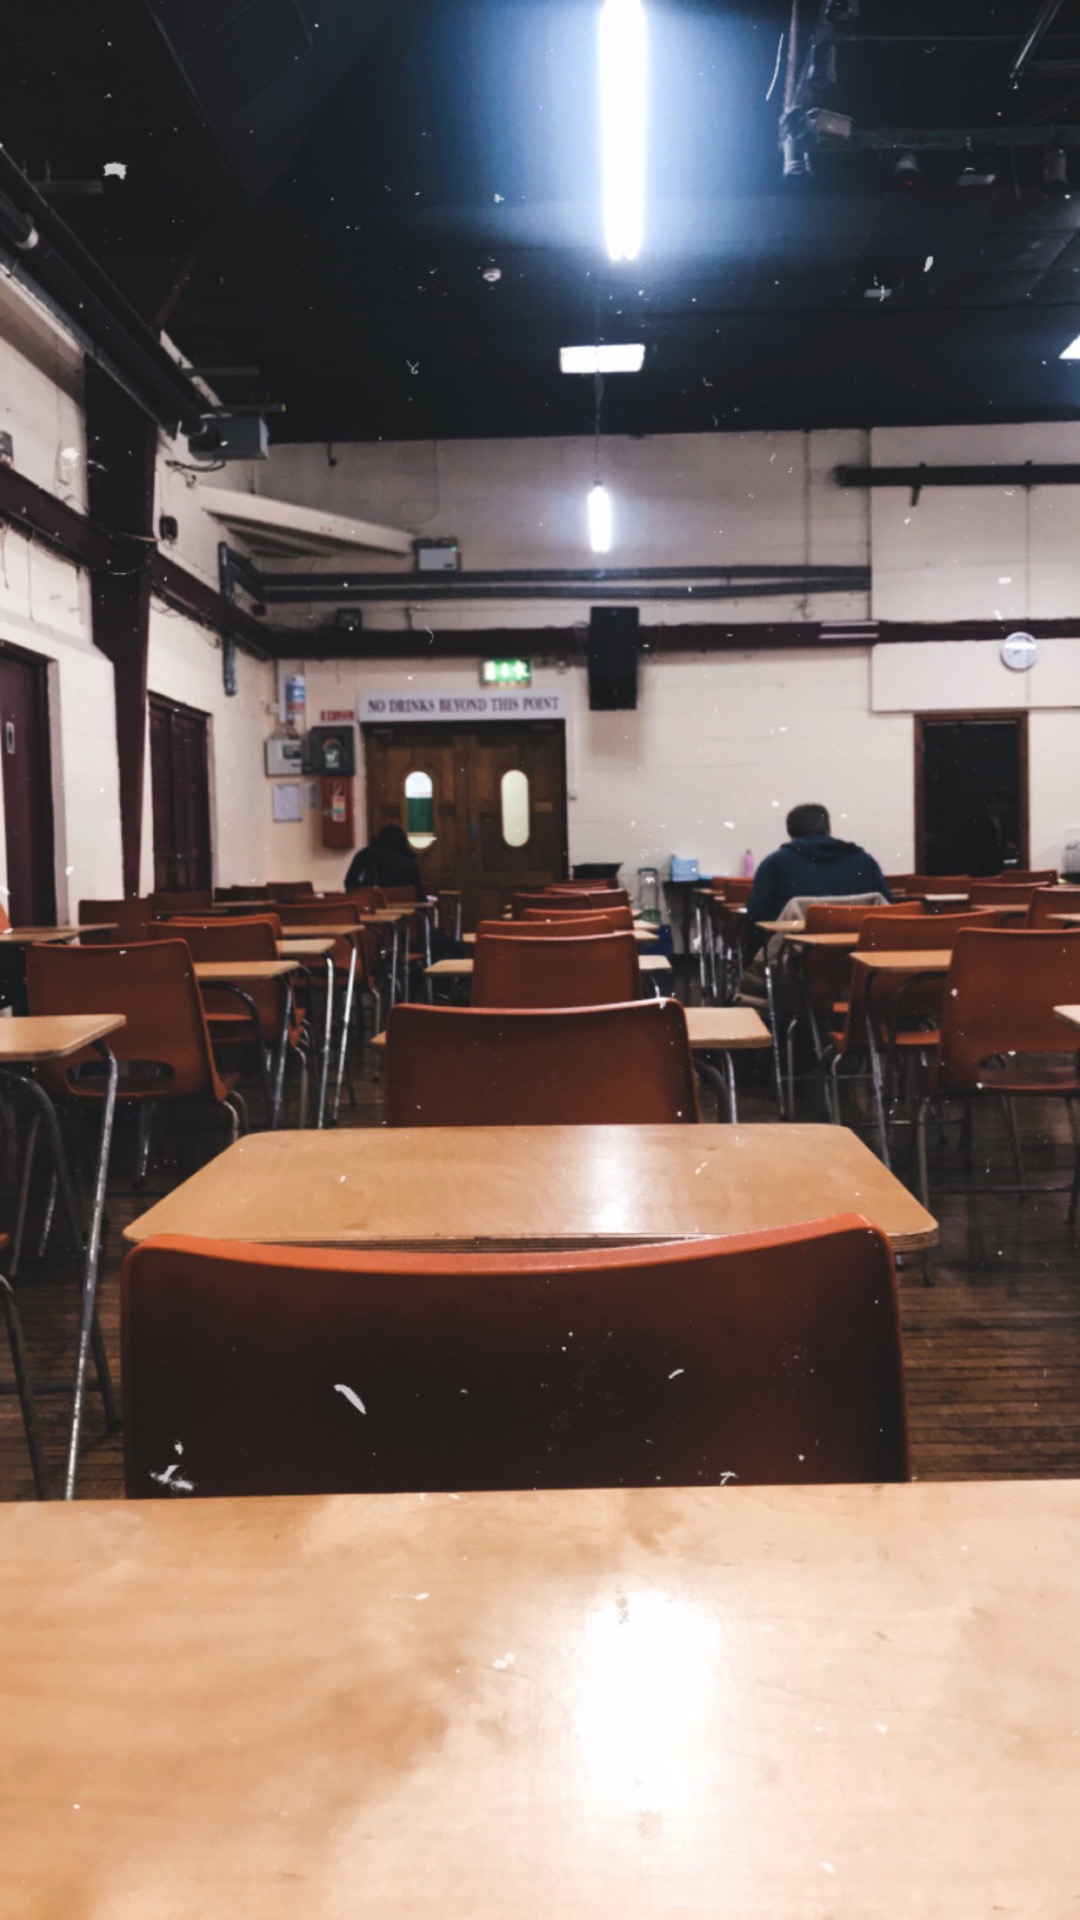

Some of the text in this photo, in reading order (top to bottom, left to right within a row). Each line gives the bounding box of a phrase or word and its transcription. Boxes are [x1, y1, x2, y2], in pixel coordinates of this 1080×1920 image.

[367, 696, 559, 713] NO DRINKS BEYOND THIS POINT
